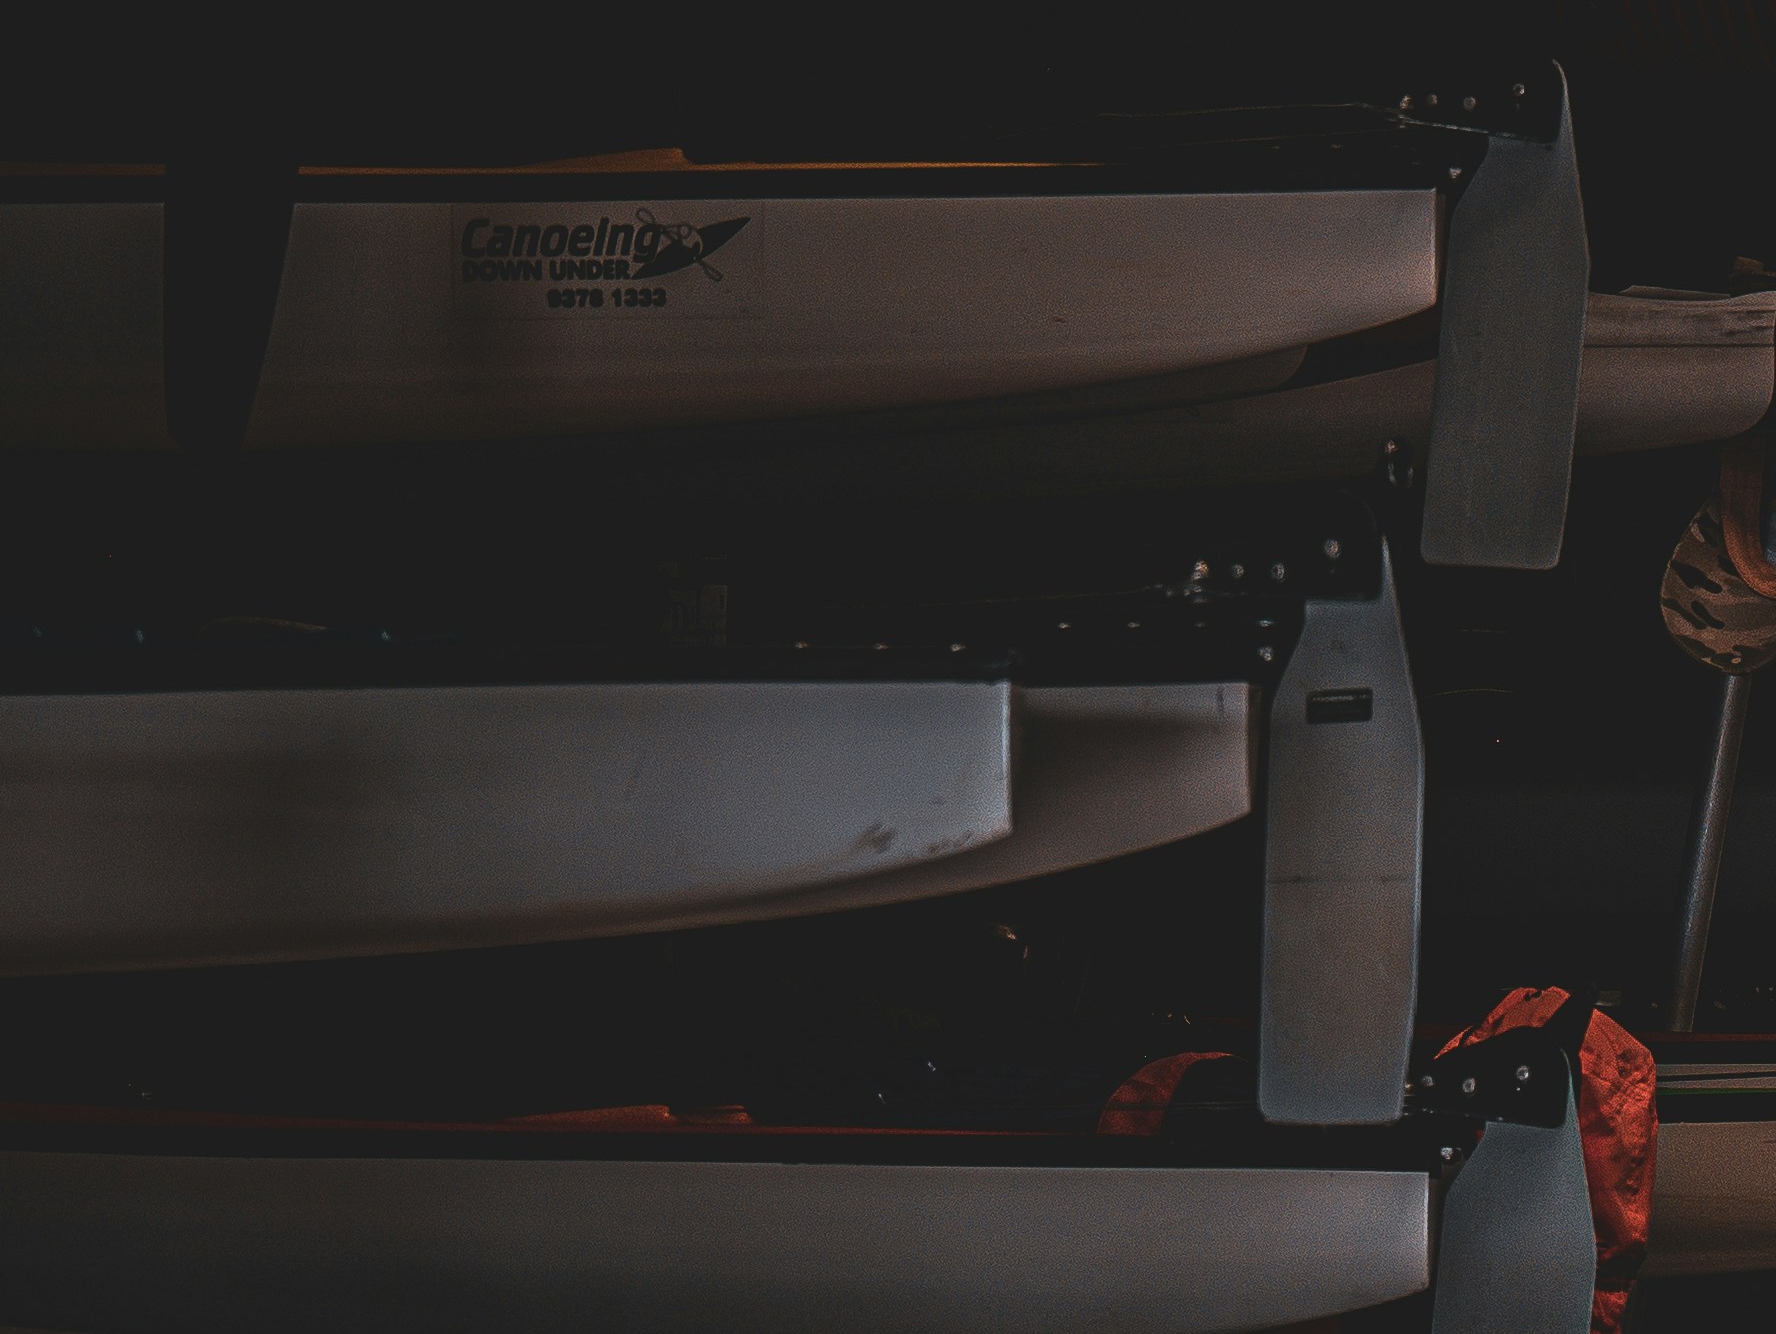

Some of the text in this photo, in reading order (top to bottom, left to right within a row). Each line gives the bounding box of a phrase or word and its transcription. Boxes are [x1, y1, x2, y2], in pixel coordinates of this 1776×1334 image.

[461, 217, 663, 263] Canoeing
[462, 259, 631, 283] DOWN UNDER
[547, 288, 667, 307] 9378 1333
